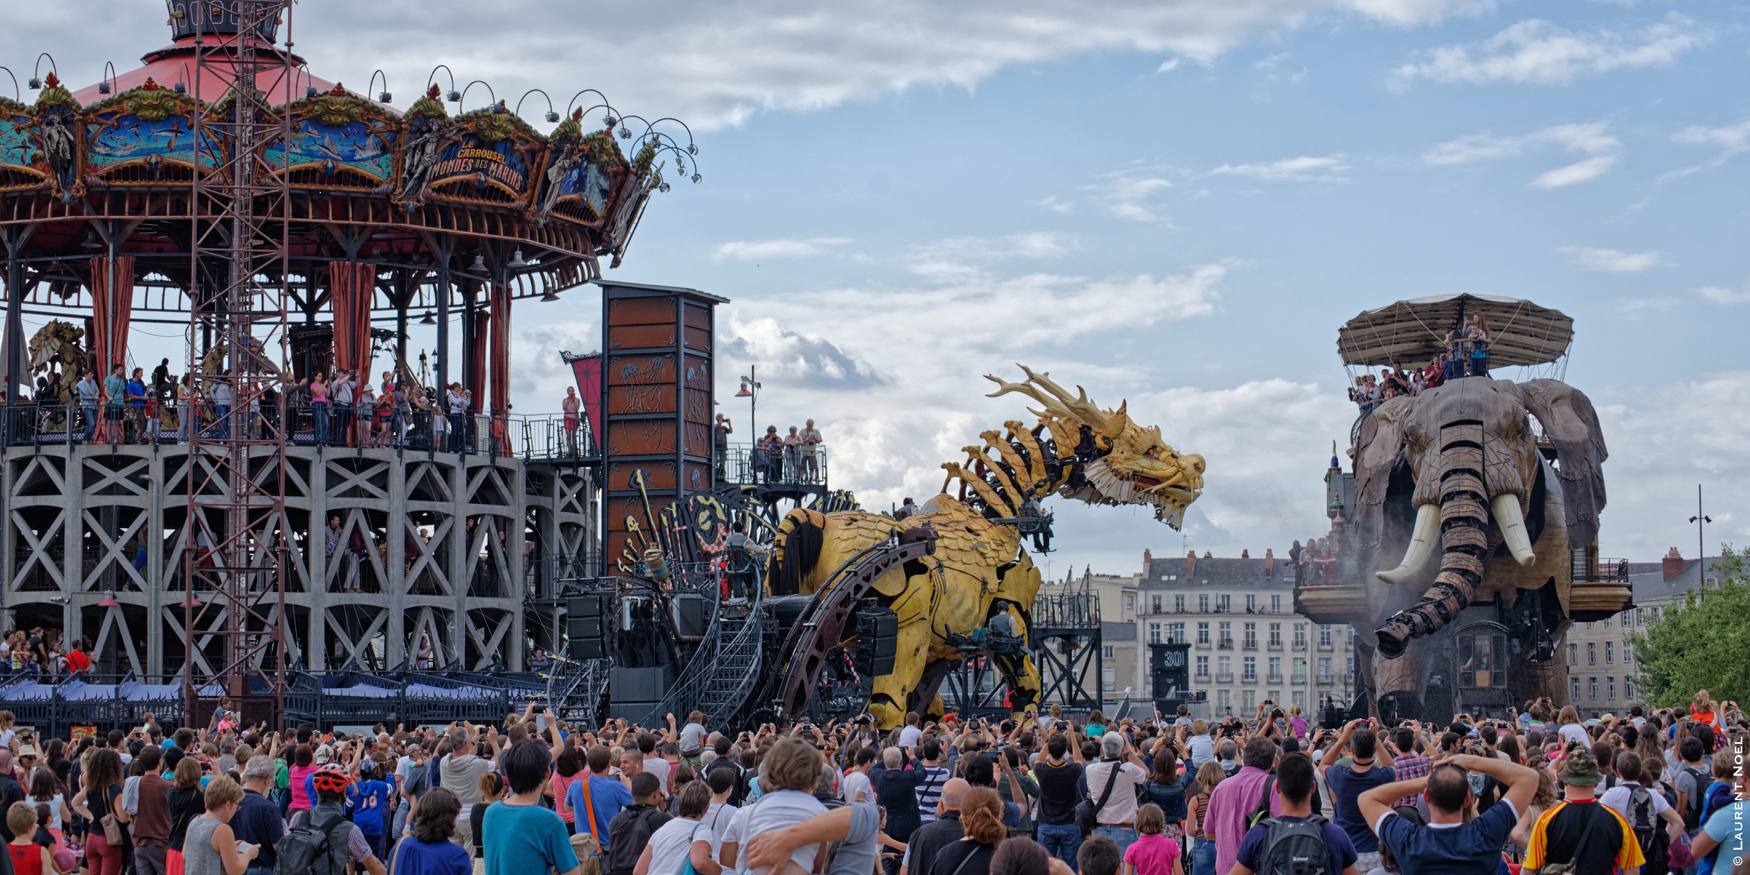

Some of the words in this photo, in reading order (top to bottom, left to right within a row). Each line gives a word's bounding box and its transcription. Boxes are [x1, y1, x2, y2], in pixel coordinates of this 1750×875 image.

[462, 141, 475, 149] LE
[457, 148, 506, 165] CARROUSEL
[430, 158, 475, 180] MONDES
[475, 159, 488, 169] DES
[487, 161, 523, 190] MARINS
